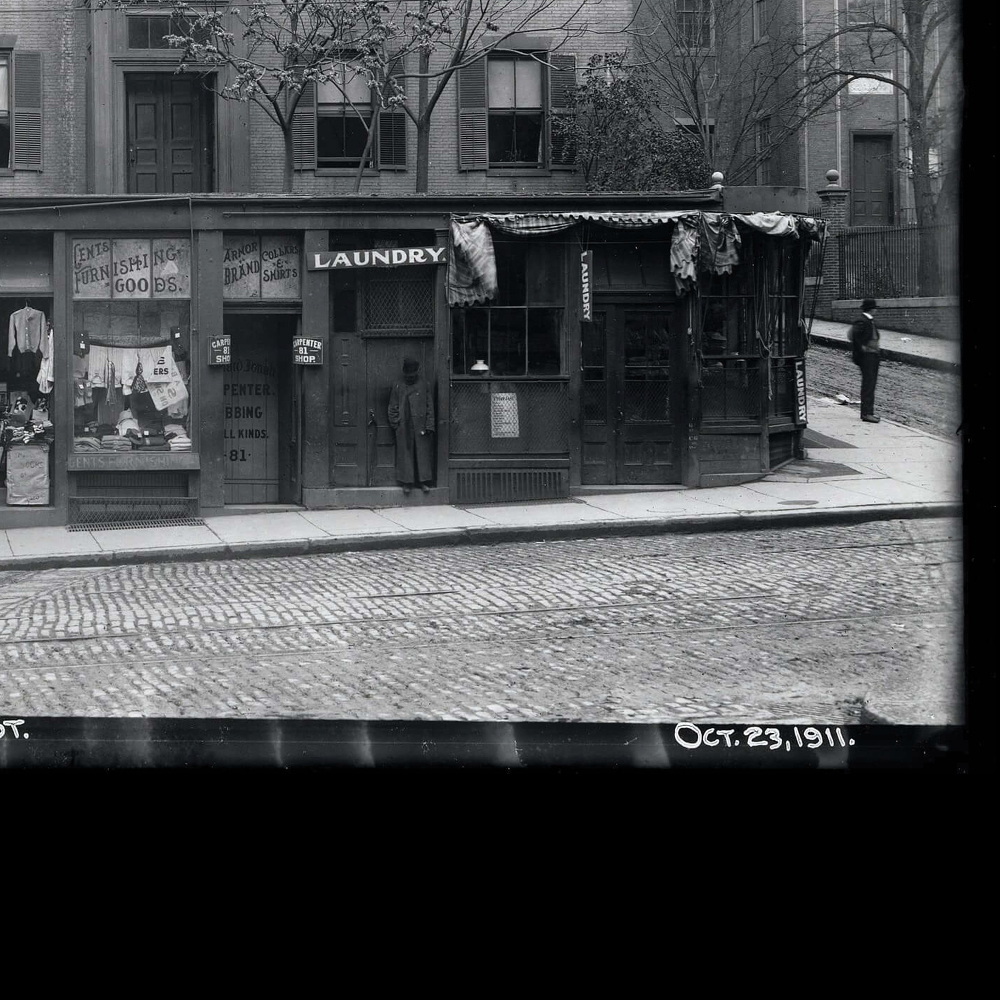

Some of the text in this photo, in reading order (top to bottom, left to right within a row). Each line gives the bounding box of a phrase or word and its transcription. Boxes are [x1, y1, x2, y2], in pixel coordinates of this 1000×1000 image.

[74, 241, 110, 269] GENTS
[261, 245, 299, 262] COLLARS
[314, 247, 447, 268] LAUNDRY.
[224, 260, 260, 286] BRAND
[262, 268, 298, 282] SHIRTS
[115, 276, 183, 293] GOODS.
[580, 250, 591, 320] LAUNDRY
[293, 338, 322, 350] CARPENTER
[298, 346, 308, 355] 81
[295, 355, 316, 363] SHOP.
[223, 383, 275, 396] PENTER.
[795, 361, 806, 421] LAUNDRY
[225, 406, 263, 419] BBING
[238, 428, 269, 439] KINDS.
